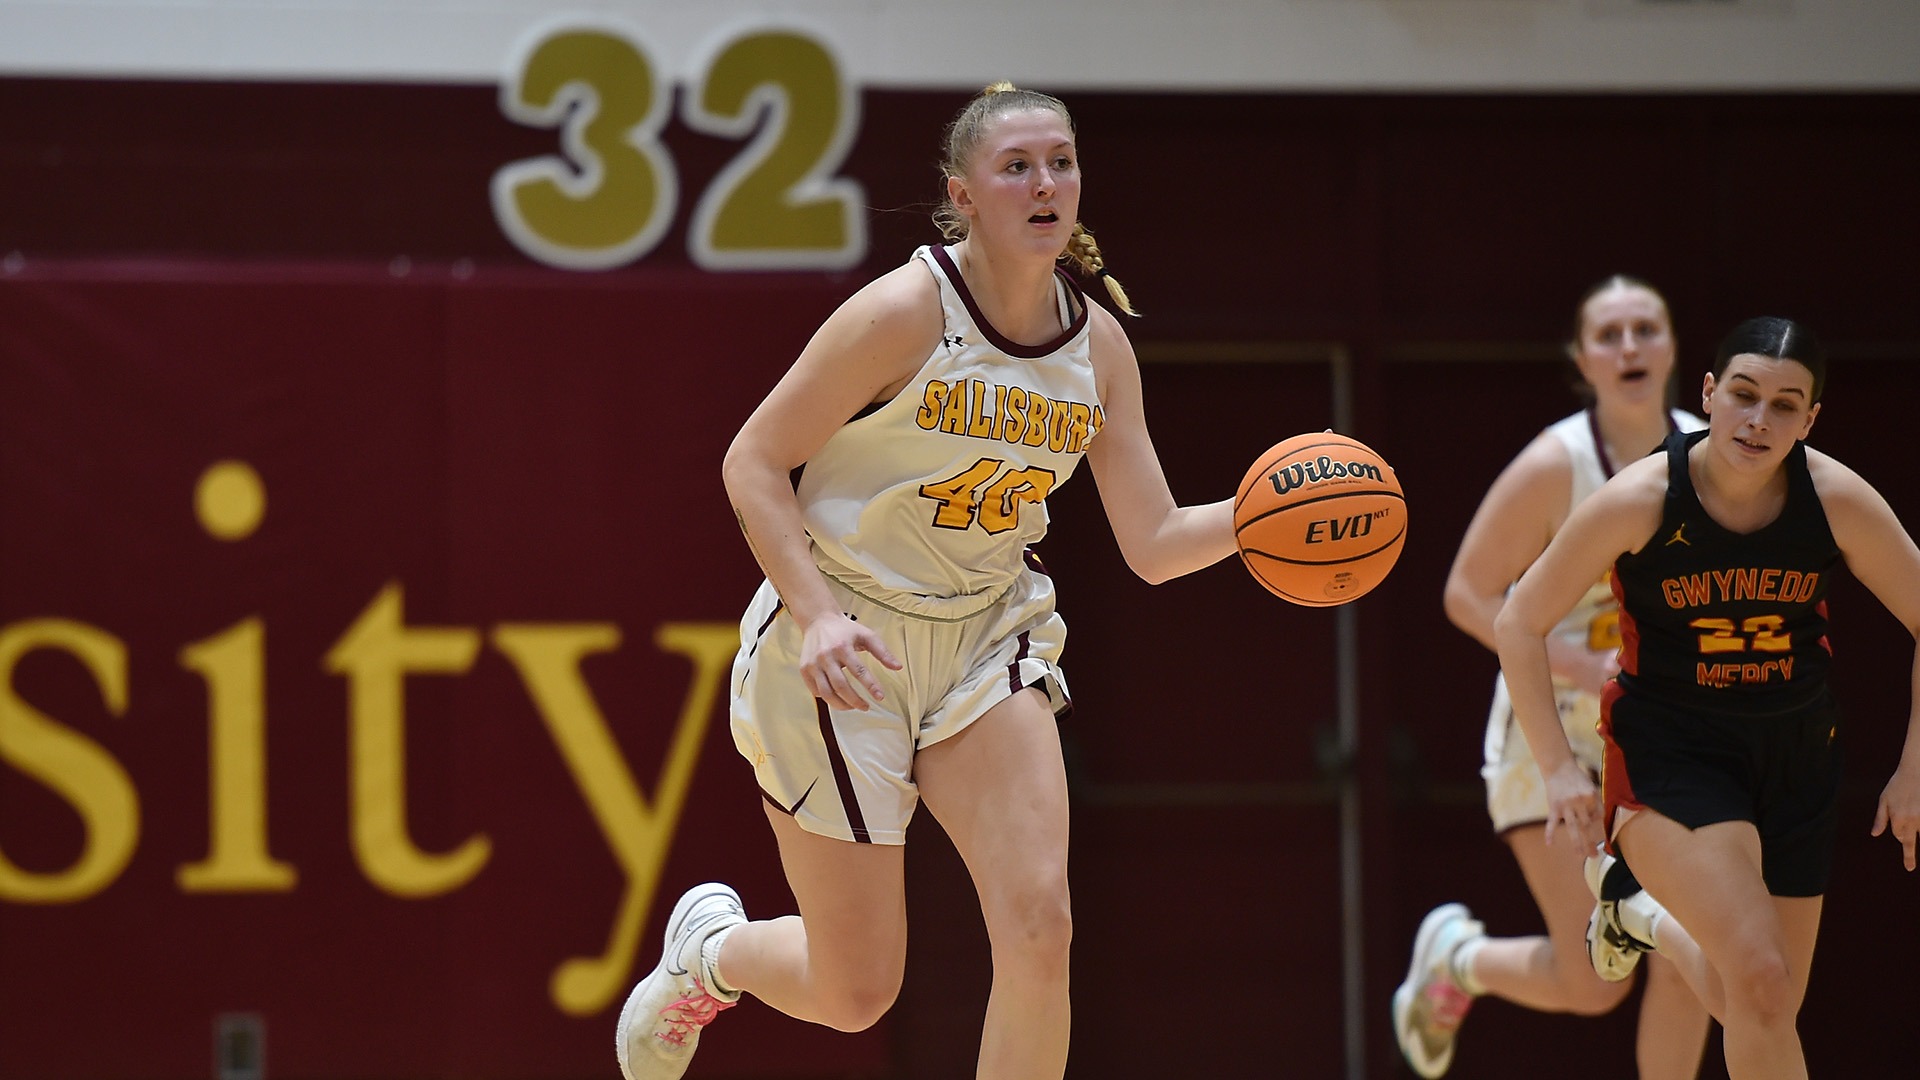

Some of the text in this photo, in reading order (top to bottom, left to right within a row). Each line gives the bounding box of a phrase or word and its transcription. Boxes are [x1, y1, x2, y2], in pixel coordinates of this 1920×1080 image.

[490, 18, 867, 270] 32
[1268, 456, 1384, 495] Wilson
[919, 458, 1056, 536] 40
[1305, 508, 1390, 545] EVO NXT
[1661, 567, 1819, 609] GWYNEDD
[1688, 614, 1792, 654] 22
[0, 460, 739, 1017] sity
